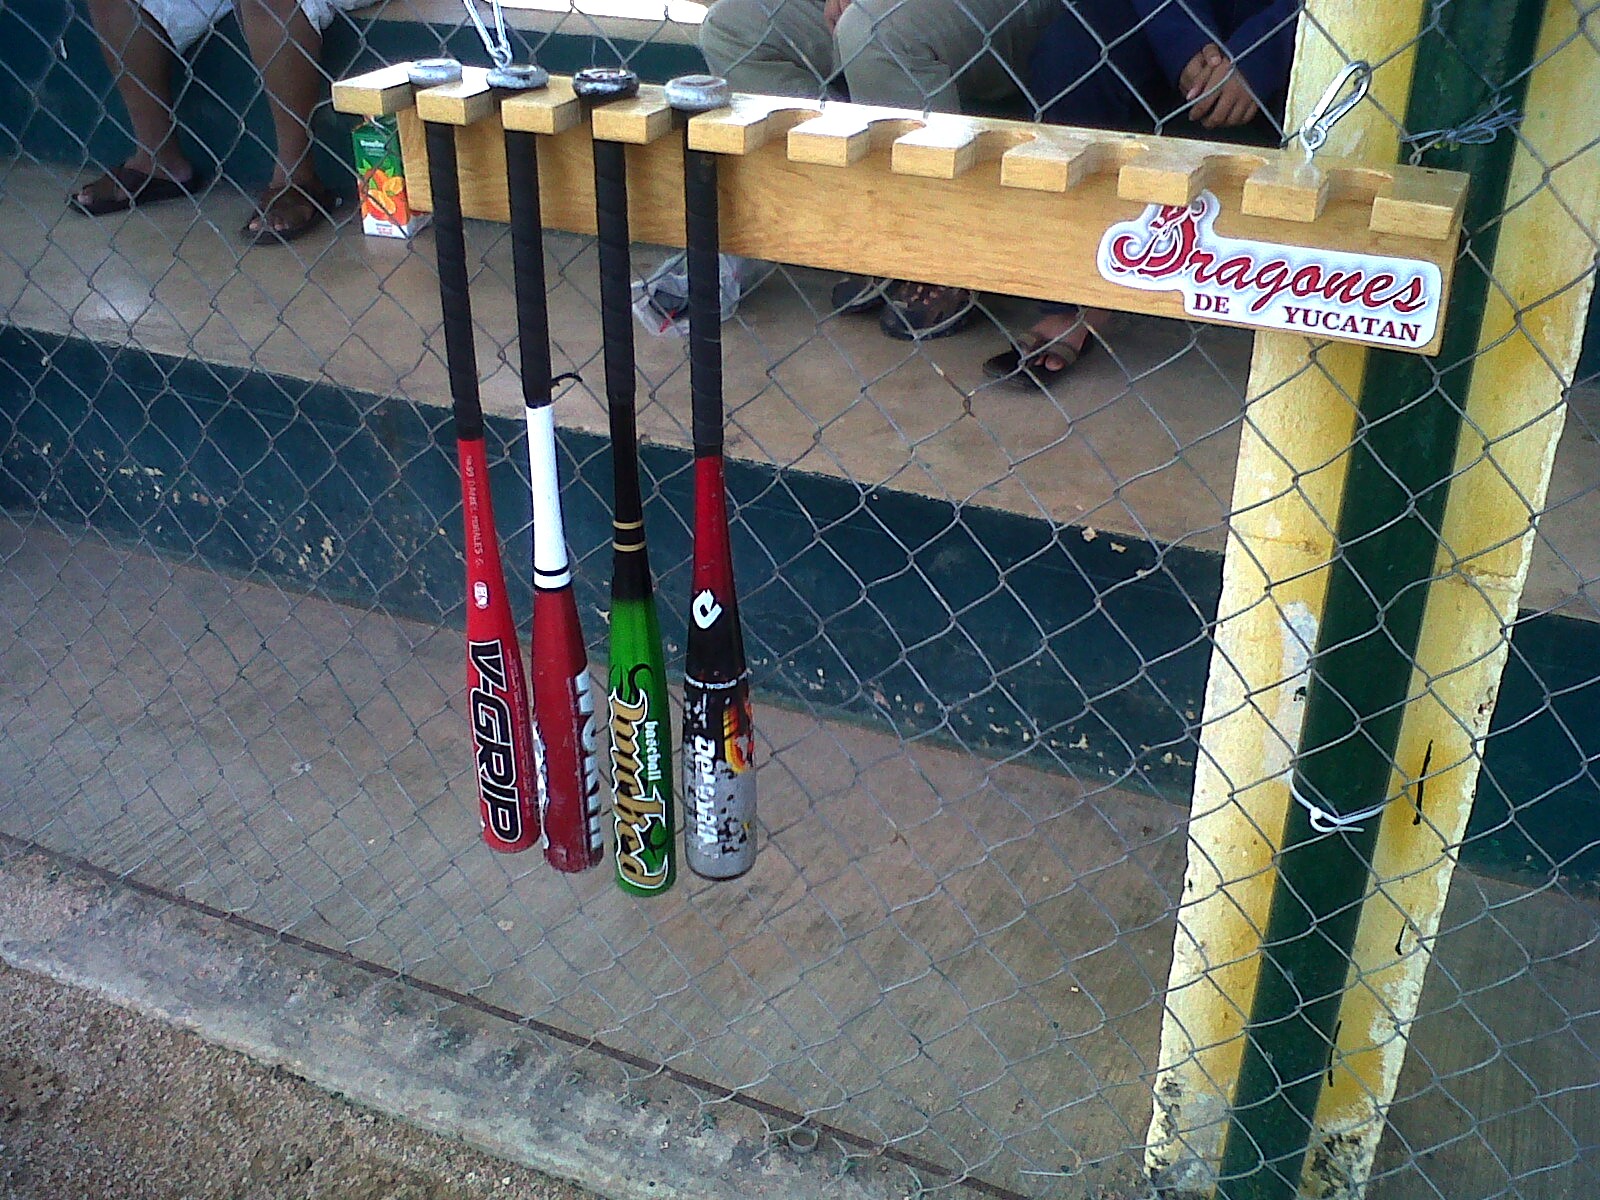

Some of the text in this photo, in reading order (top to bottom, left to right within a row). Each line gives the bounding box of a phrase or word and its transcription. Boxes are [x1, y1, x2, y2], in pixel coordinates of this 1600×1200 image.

[1110, 200, 1427, 313] Dragones
[1192, 293, 1421, 342] DE YUCATAN
[469, 639, 522, 843] V-GRIP
[644, 721, 662, 781] baseball
